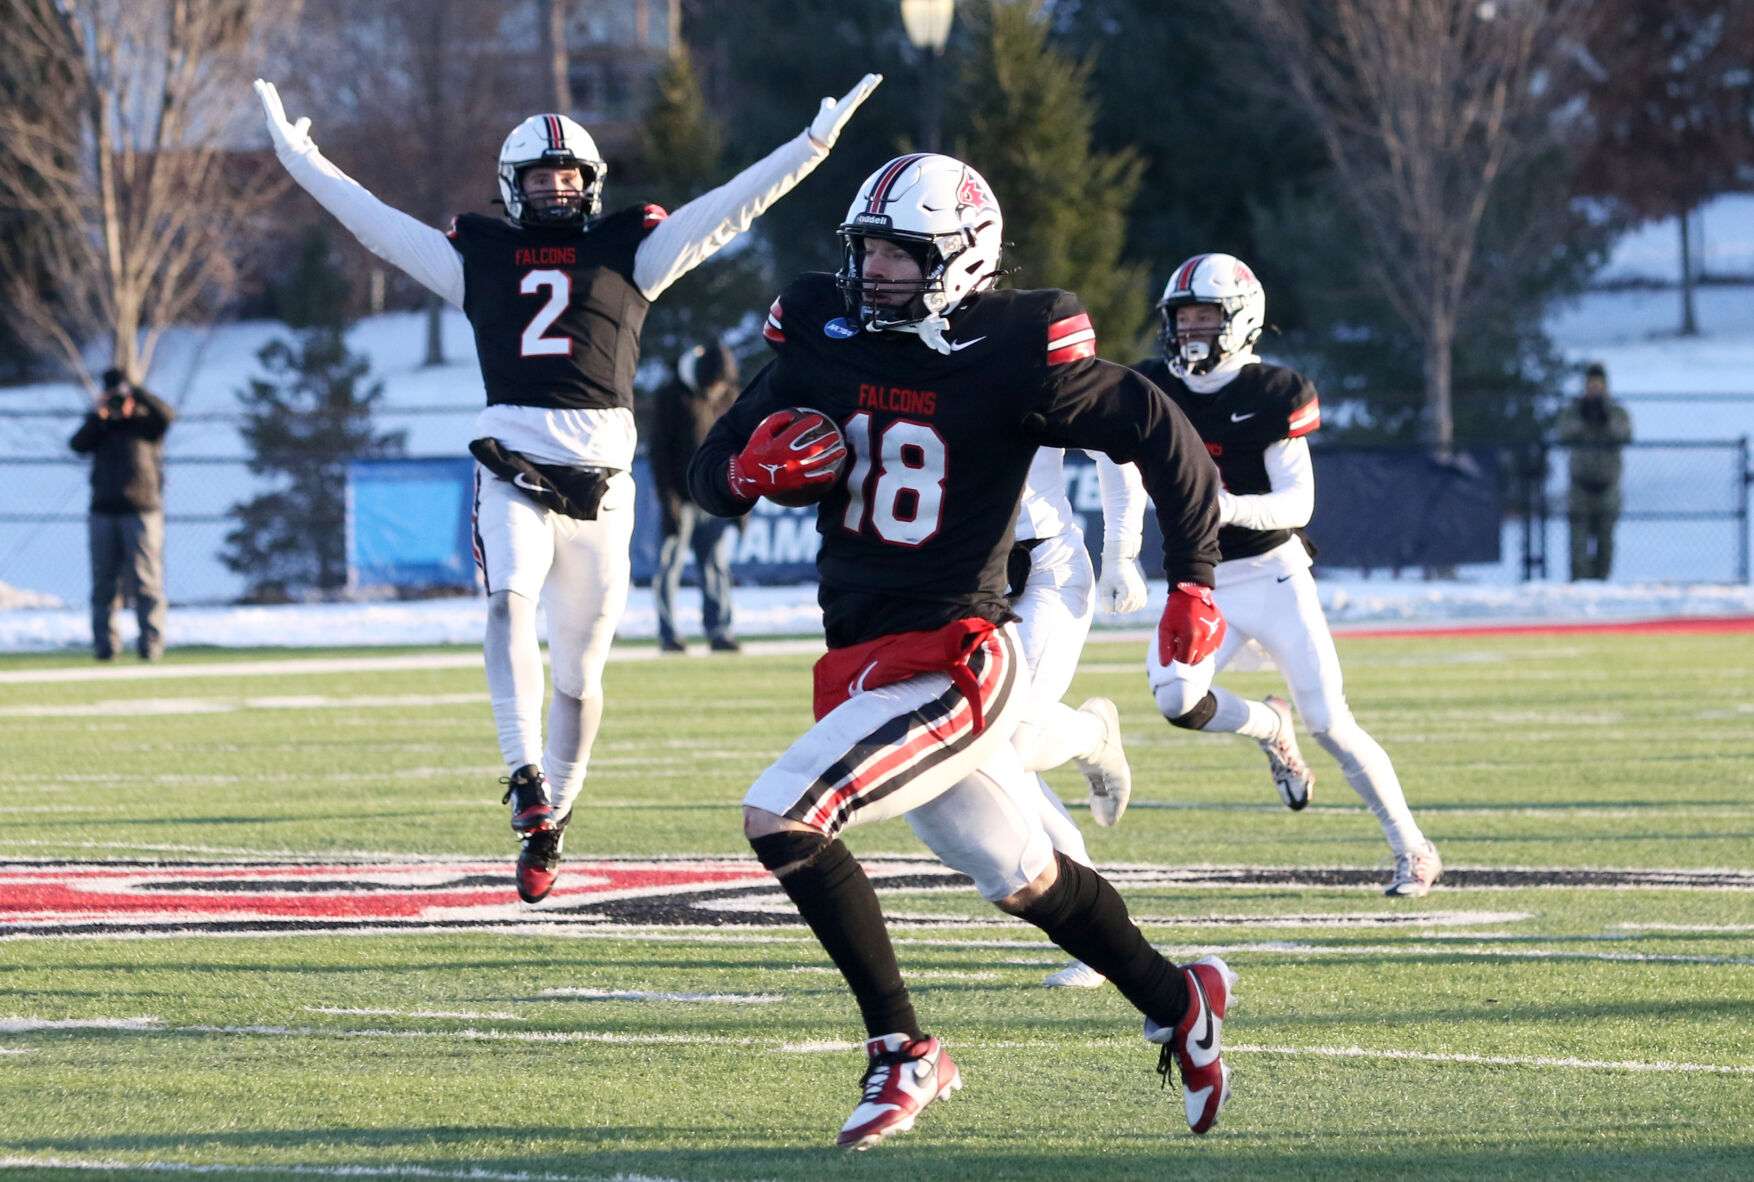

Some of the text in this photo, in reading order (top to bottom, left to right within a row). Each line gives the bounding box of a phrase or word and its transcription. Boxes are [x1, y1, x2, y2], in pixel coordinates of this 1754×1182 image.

[515, 247, 576, 265] FALCONS
[519, 269, 572, 358] 2
[859, 384, 937, 416] FALCONS
[843, 409, 949, 548] 18
